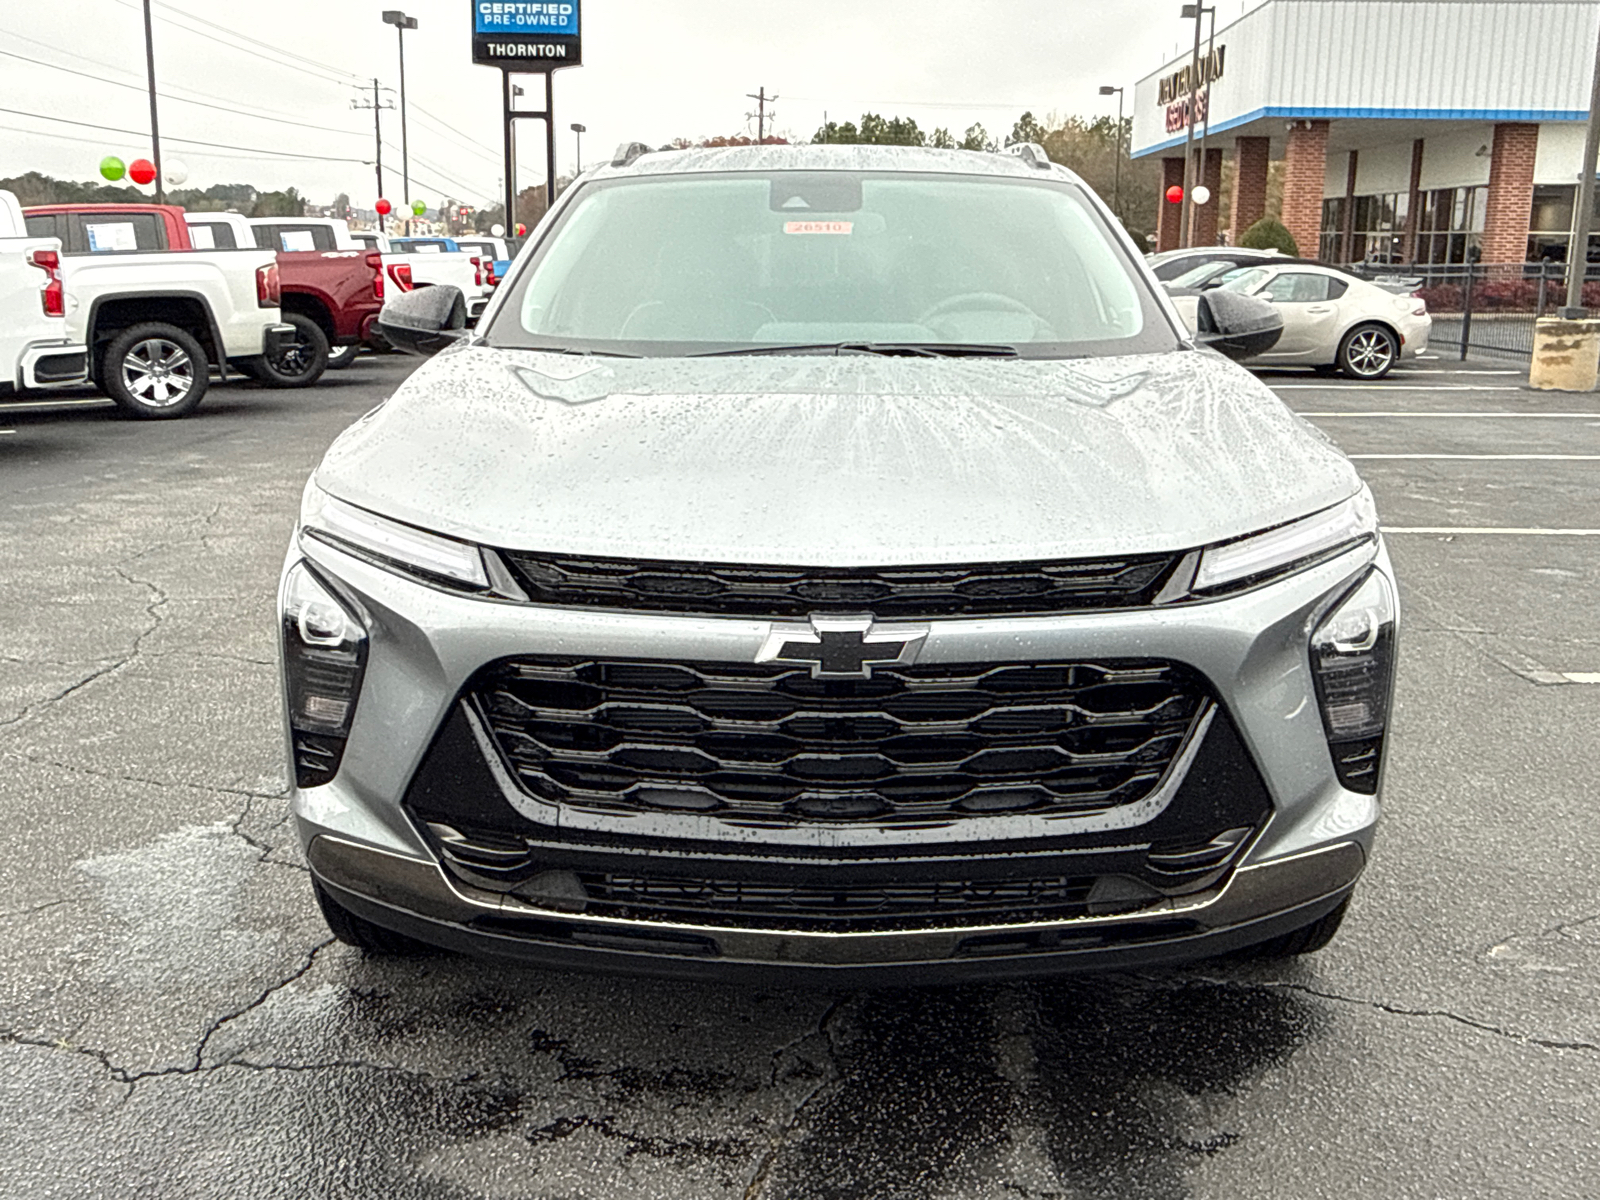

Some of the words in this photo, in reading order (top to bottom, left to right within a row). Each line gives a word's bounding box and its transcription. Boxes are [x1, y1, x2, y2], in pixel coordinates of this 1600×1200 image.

[479, 3, 573, 15] CERTIFIED
[484, 14, 568, 26] PRE-OWNED
[487, 43, 566, 57] THORNTON
[794, 223, 842, 232] 26510
